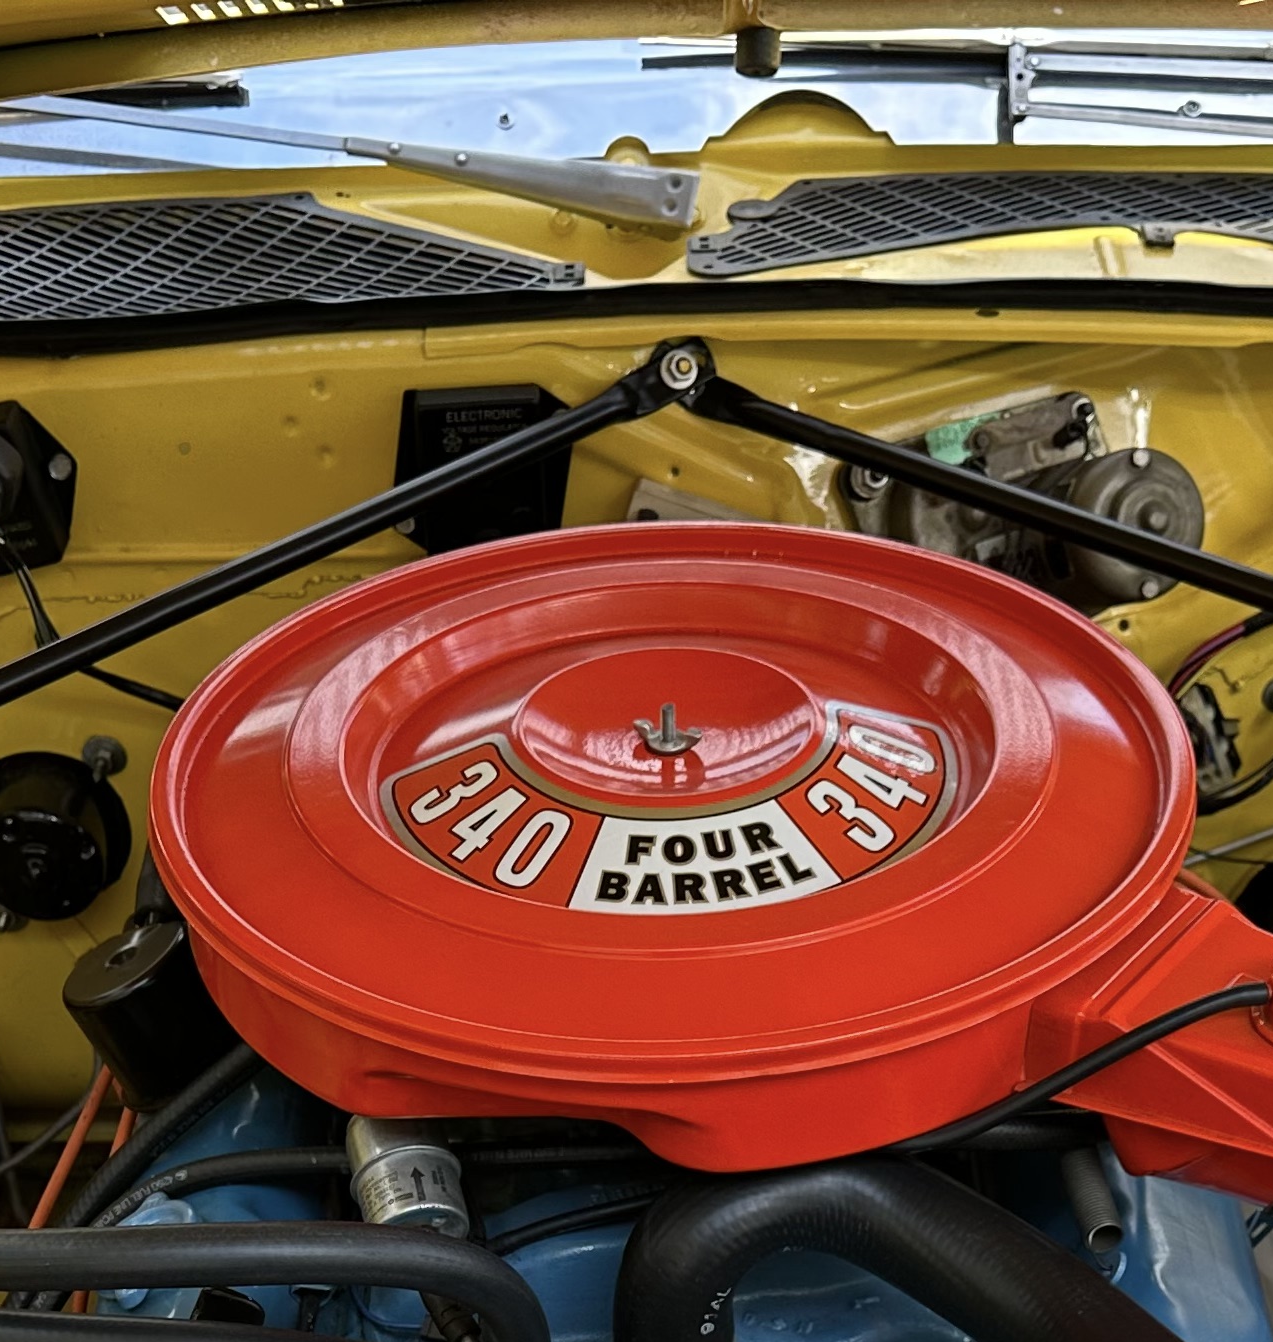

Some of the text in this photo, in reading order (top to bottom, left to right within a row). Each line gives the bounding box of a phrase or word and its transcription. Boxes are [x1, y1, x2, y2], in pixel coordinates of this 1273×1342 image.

[446, 408, 523, 423] ELECTRONIC
[805, 723, 939, 855] 340
[409, 759, 571, 888] 340
[625, 819, 782, 867] FOUR
[595, 851, 817, 907] BARREL
